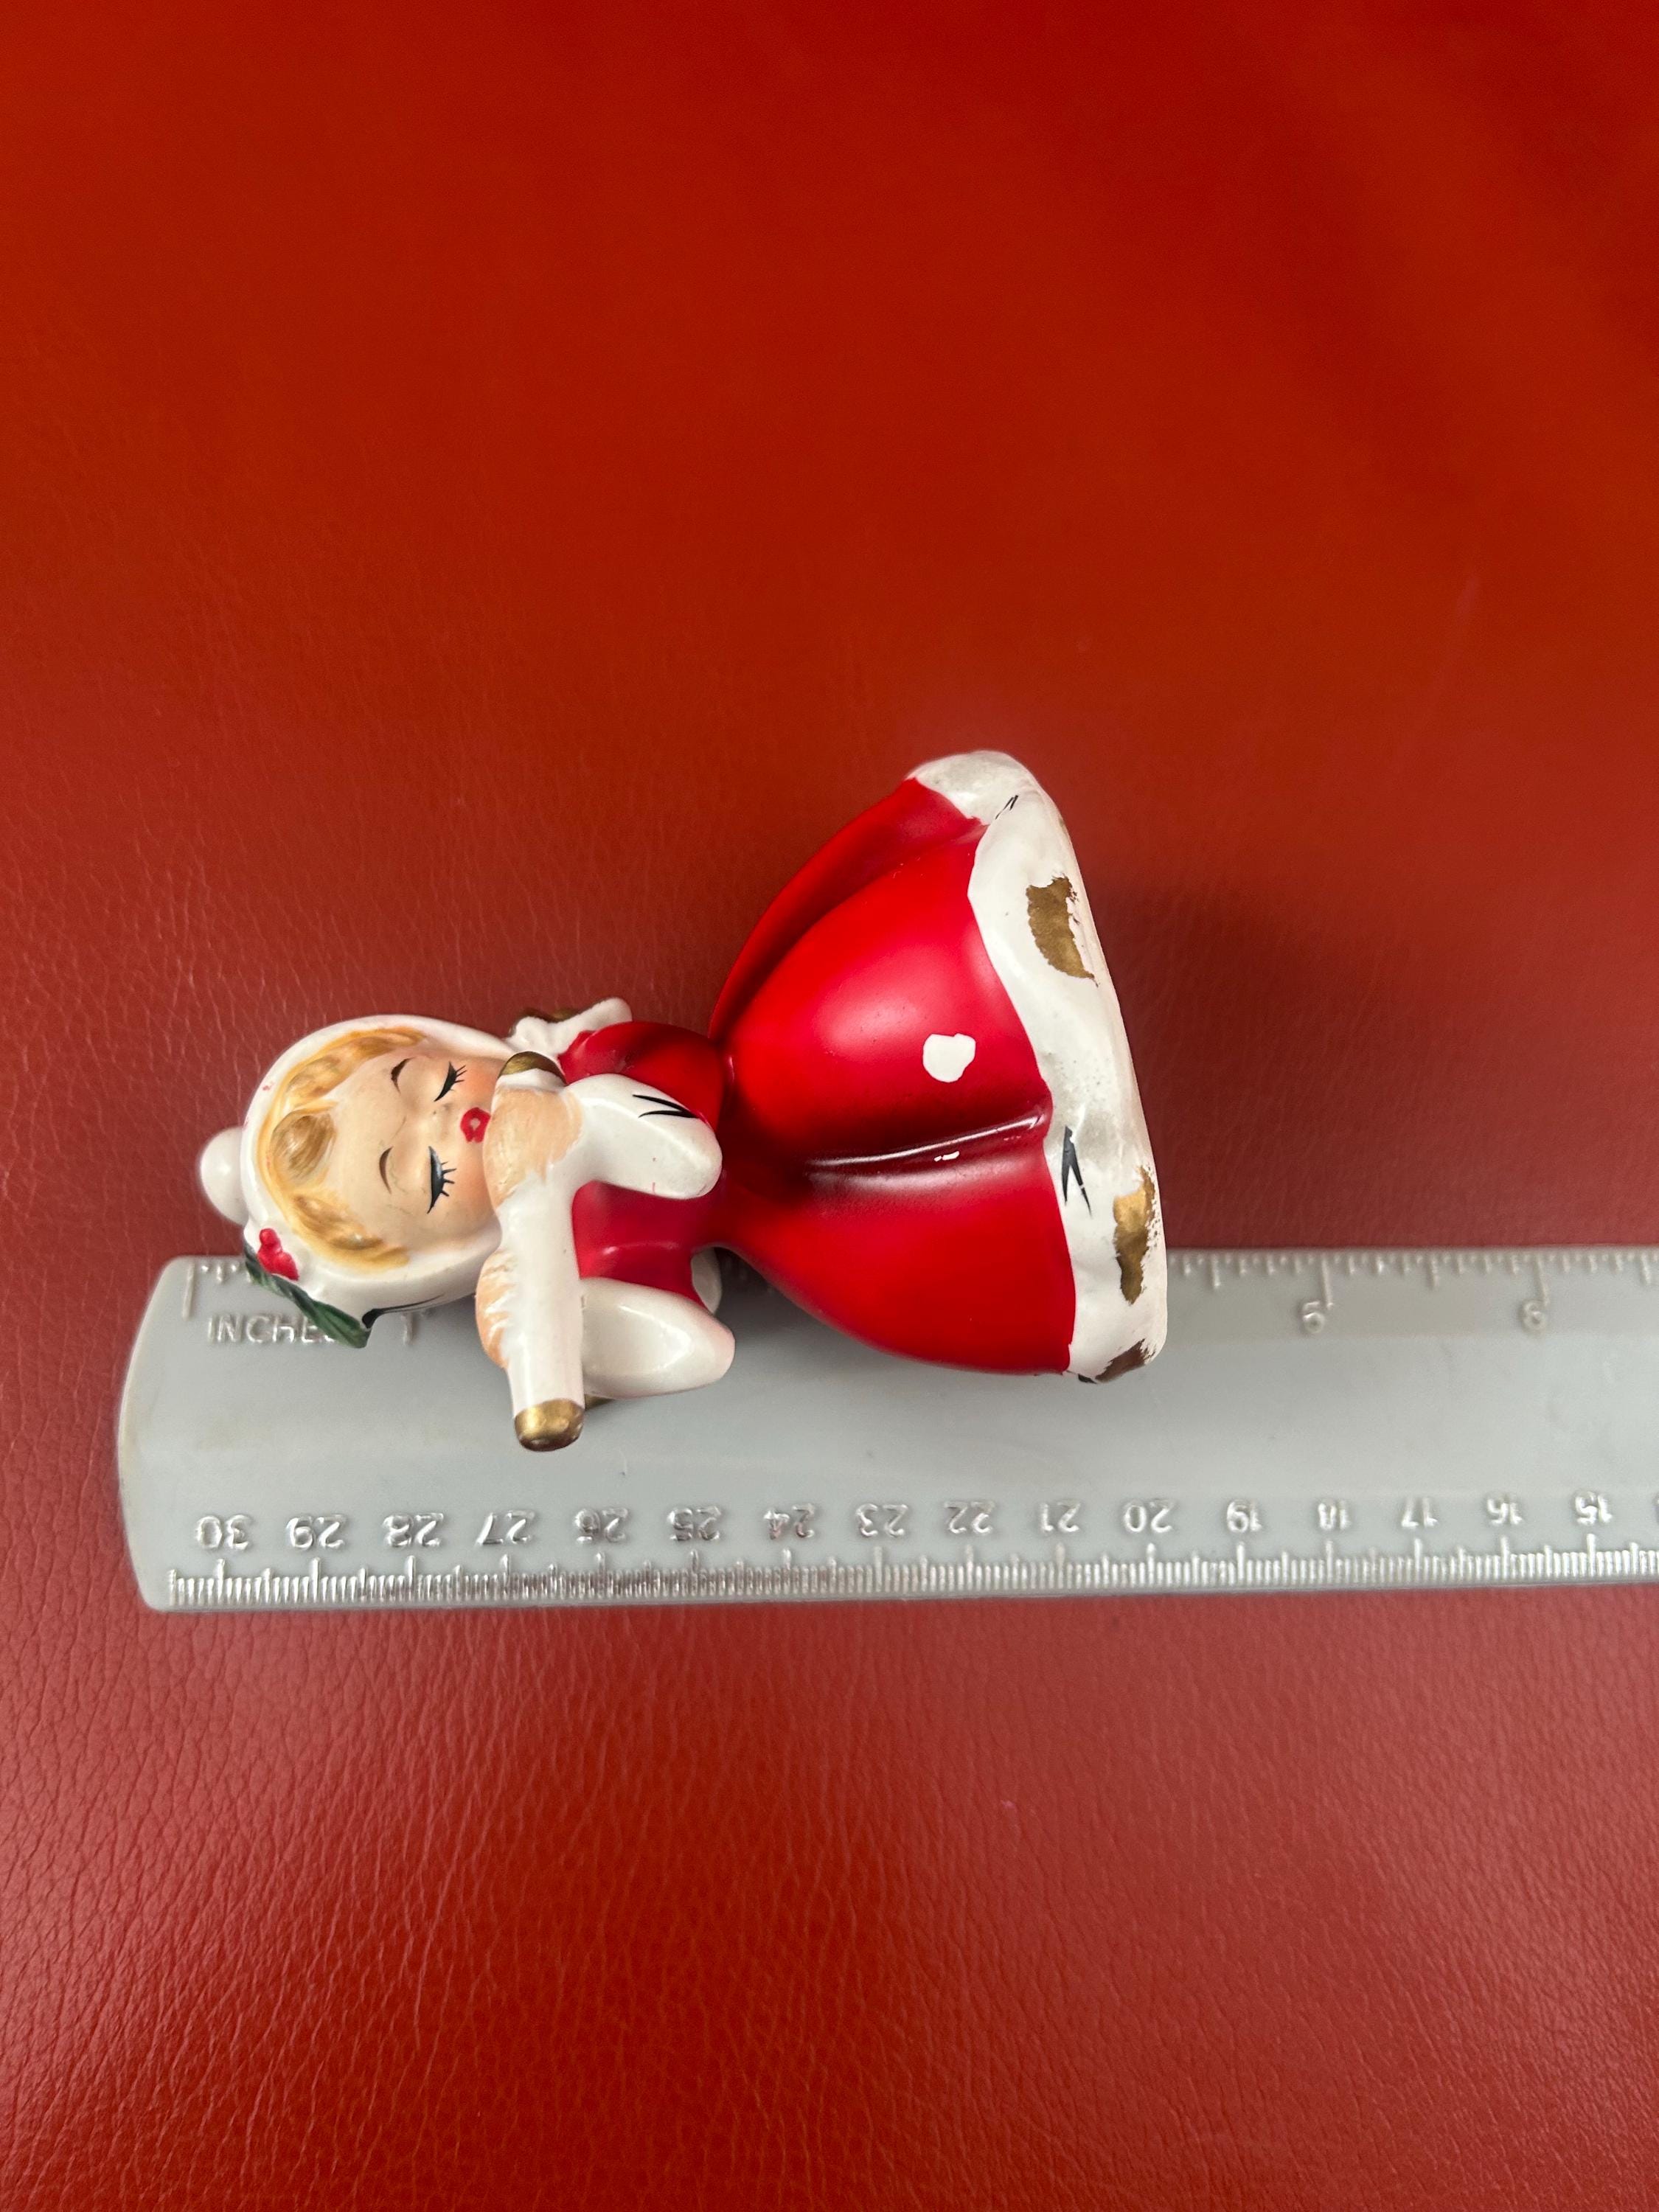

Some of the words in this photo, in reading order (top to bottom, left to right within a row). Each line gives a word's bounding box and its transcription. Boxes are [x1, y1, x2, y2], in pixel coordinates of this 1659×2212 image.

[207, 1313, 335, 1344] INCHE
[1301, 1300, 1326, 1335] 5
[1522, 1299, 1546, 1335] 6
[574, 1506, 629, 1544] 26
[667, 1505, 722, 1541] 25
[762, 1503, 815, 1540] 24
[855, 1503, 908, 1538] 23
[945, 1500, 995, 1534] 22
[1038, 1499, 1082, 1534] 21
[1123, 1498, 1175, 1534] 20
[1225, 1498, 1262, 1533] 19
[1401, 1496, 1439, 1528] 17
[1486, 1493, 1523, 1526] 16
[1574, 1491, 1613, 1526] 15
[195, 1514, 252, 1549] 30
[286, 1513, 346, 1549] 29
[383, 1512, 444, 1548] 28
[476, 1510, 535, 1546] 27
